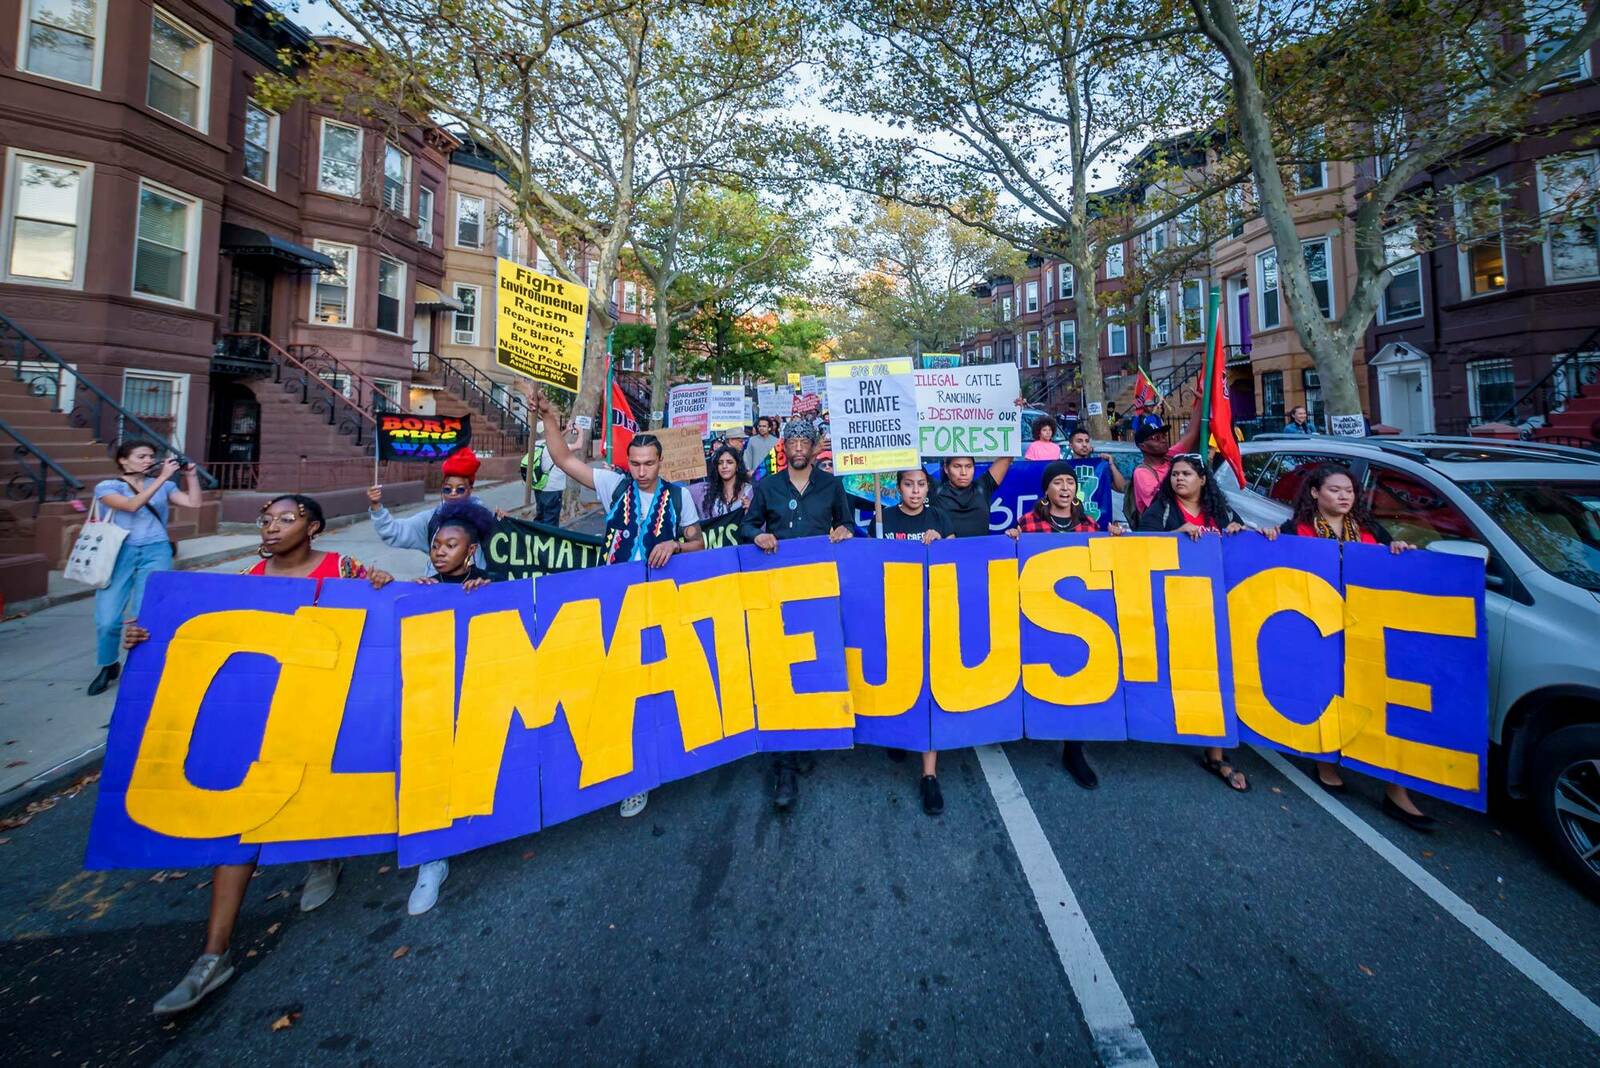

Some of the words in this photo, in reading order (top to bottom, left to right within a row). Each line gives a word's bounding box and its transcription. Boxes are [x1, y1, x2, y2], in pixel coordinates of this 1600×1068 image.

[516, 268, 564, 295] Fight
[501, 276, 583, 315] Environmental
[515, 296, 568, 323] Racism
[503, 306, 575, 338] Reparations
[512, 322, 527, 334] for
[530, 327, 566, 348] Black,
[511, 332, 552, 354] Brown,
[555, 348, 564, 358] &
[499, 338, 535, 359] Native
[538, 354, 578, 374] People
[550, 374, 567, 384] NYC
[859, 379, 882, 396] PAY
[914, 374, 959, 387] ILLEGAL
[965, 374, 1002, 387] CATTLE
[672, 399, 684, 407] FOR
[684, 397, 708, 406] CLIMATE
[844, 395, 901, 415] CLIMATE
[936, 390, 982, 404] RANCHING
[916, 411, 925, 421] IS
[927, 406, 994, 421] DESTROYING
[998, 411, 1017, 422] OUR
[382, 416, 462, 433] BORN
[848, 418, 902, 434] REFUGEES
[389, 429, 457, 443] THIS
[840, 433, 912, 450] REPARATIONS
[918, 425, 1015, 453] FOREST
[390, 442, 457, 457] WAY
[896, 532, 906, 540] NO
[489, 532, 600, 568] CLIMAT
[125, 561, 856, 844] CLIMATE
[845, 536, 1479, 791] JUSTICE
